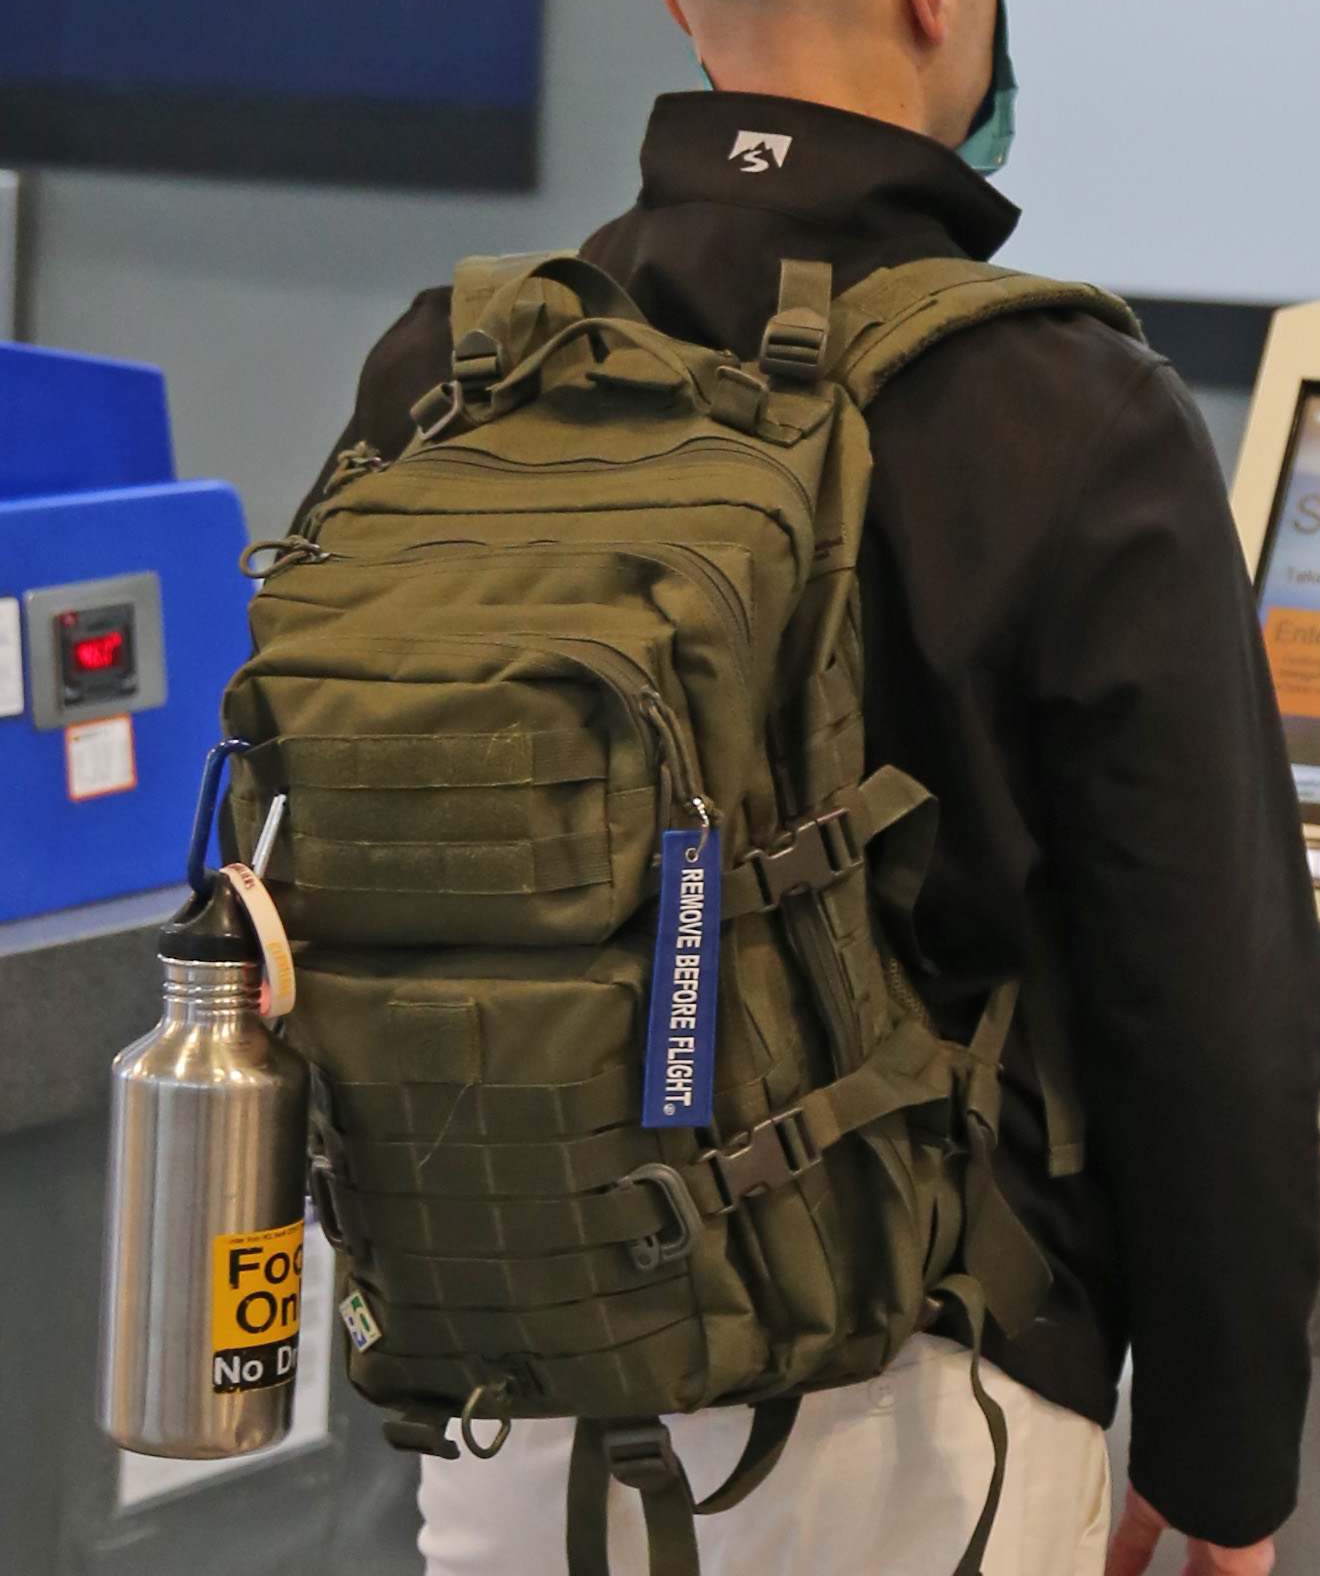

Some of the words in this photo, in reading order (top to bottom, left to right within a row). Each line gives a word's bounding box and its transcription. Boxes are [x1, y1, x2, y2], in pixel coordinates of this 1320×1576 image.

[675, 867, 705, 950] REMOVE
[669, 954, 701, 1030] BEFORE
[213, 1355, 264, 1386] No
